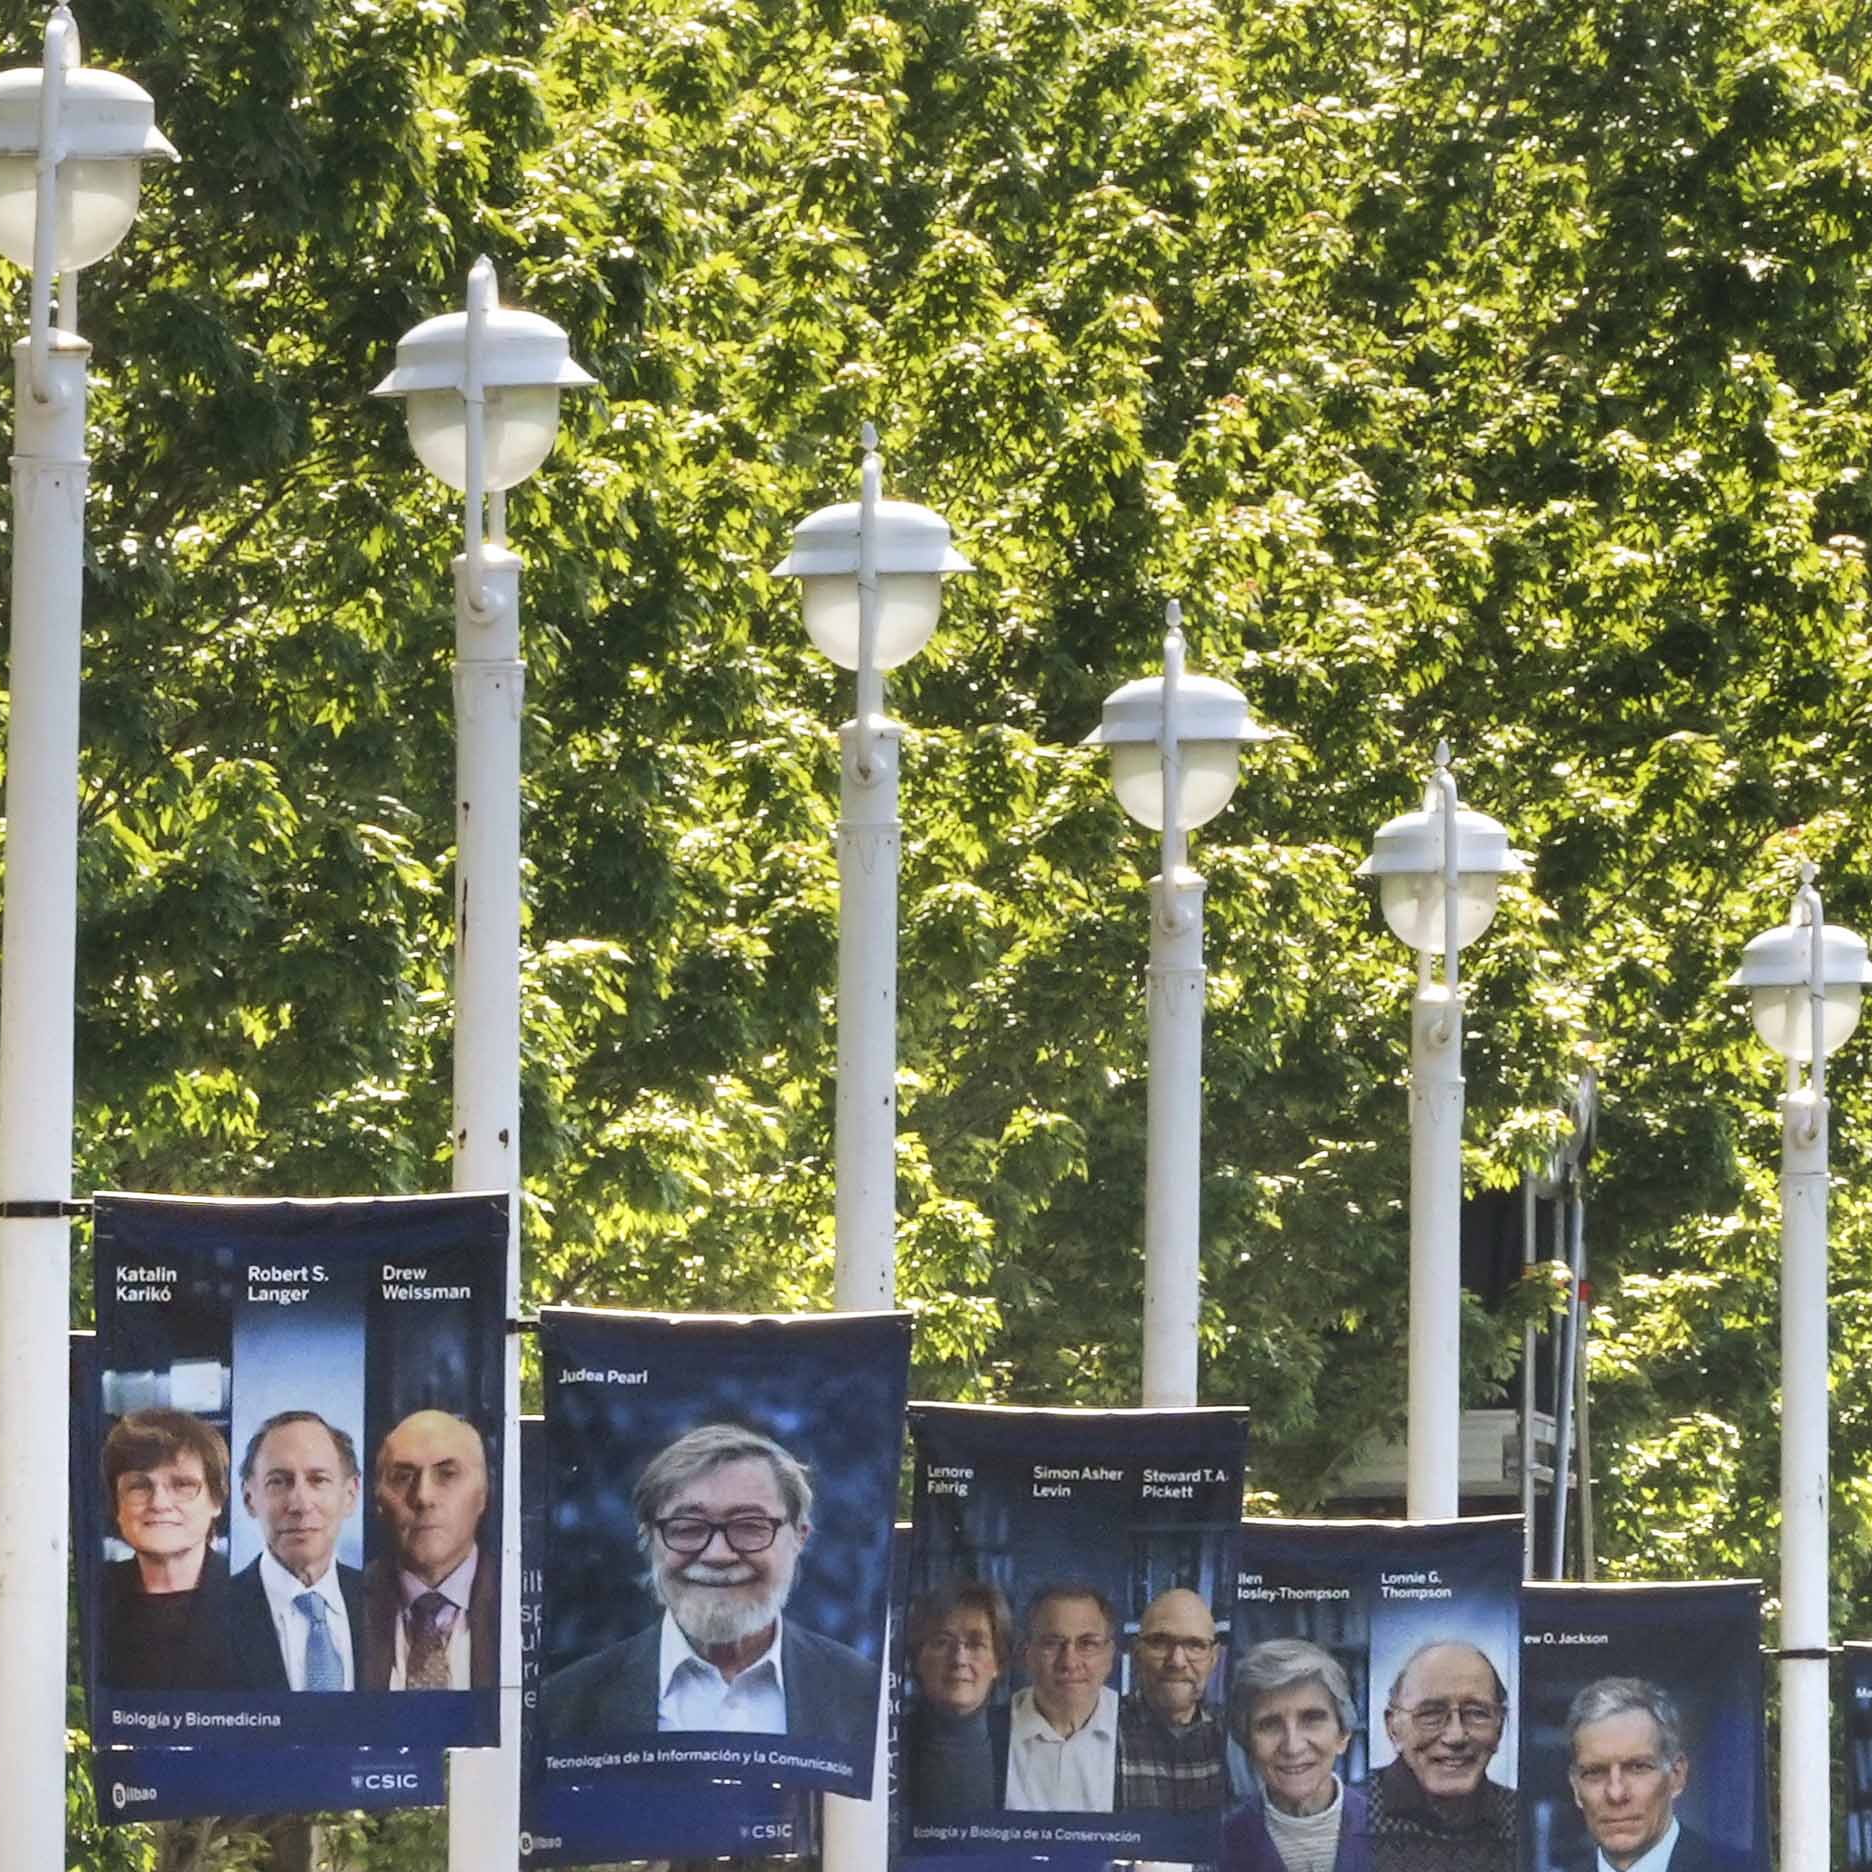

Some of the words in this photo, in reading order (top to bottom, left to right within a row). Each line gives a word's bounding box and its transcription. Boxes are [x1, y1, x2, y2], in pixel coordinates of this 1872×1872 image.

[117, 1267, 176, 1282] Katalin
[249, 1266, 308, 1281] Robert
[312, 1266, 328, 1281] S.
[383, 1265, 426, 1280] Drew
[117, 1286, 171, 1301] Karikó
[248, 1286, 309, 1304] Langer
[383, 1285, 470, 1300] Weissman
[560, 1368, 604, 1383] Judea
[608, 1370, 647, 1384] Pearl
[928, 1465, 973, 1478] Lenore
[1034, 1466, 1079, 1479] Simon
[1082, 1467, 1123, 1480] Asher
[1144, 1469, 1201, 1482] Steward
[928, 1481, 967, 1496] Fahrig
[1033, 1484, 1070, 1496] Levin
[1143, 1485, 1192, 1498] Pickett
[1382, 1573, 1426, 1584] Lonnie
[1382, 1587, 1451, 1600] Thompson
[1559, 1634, 1608, 1644] Jackson
[113, 1710, 170, 1728] Biología
[173, 1716, 182, 1729] y
[186, 1712, 280, 1726] Biomedicina
[546, 1754, 621, 1768] Tecnologías
[623, 1752, 640, 1763] de
[643, 1752, 654, 1762] la
[658, 1750, 740, 1761] Información
[743, 1753, 751, 1765] y
[754, 1751, 765, 1763] la
[769, 1752, 852, 1776] Comunicación
[366, 1774, 417, 1789] CSIC
[752, 1824, 792, 1838] CSIC
[960, 1830, 968, 1839] y
[970, 1826, 1020, 1841] Biología
[1024, 1830, 1038, 1839] de
[1042, 1830, 1052, 1839] la
[1055, 1829, 1140, 1842] Conservación
